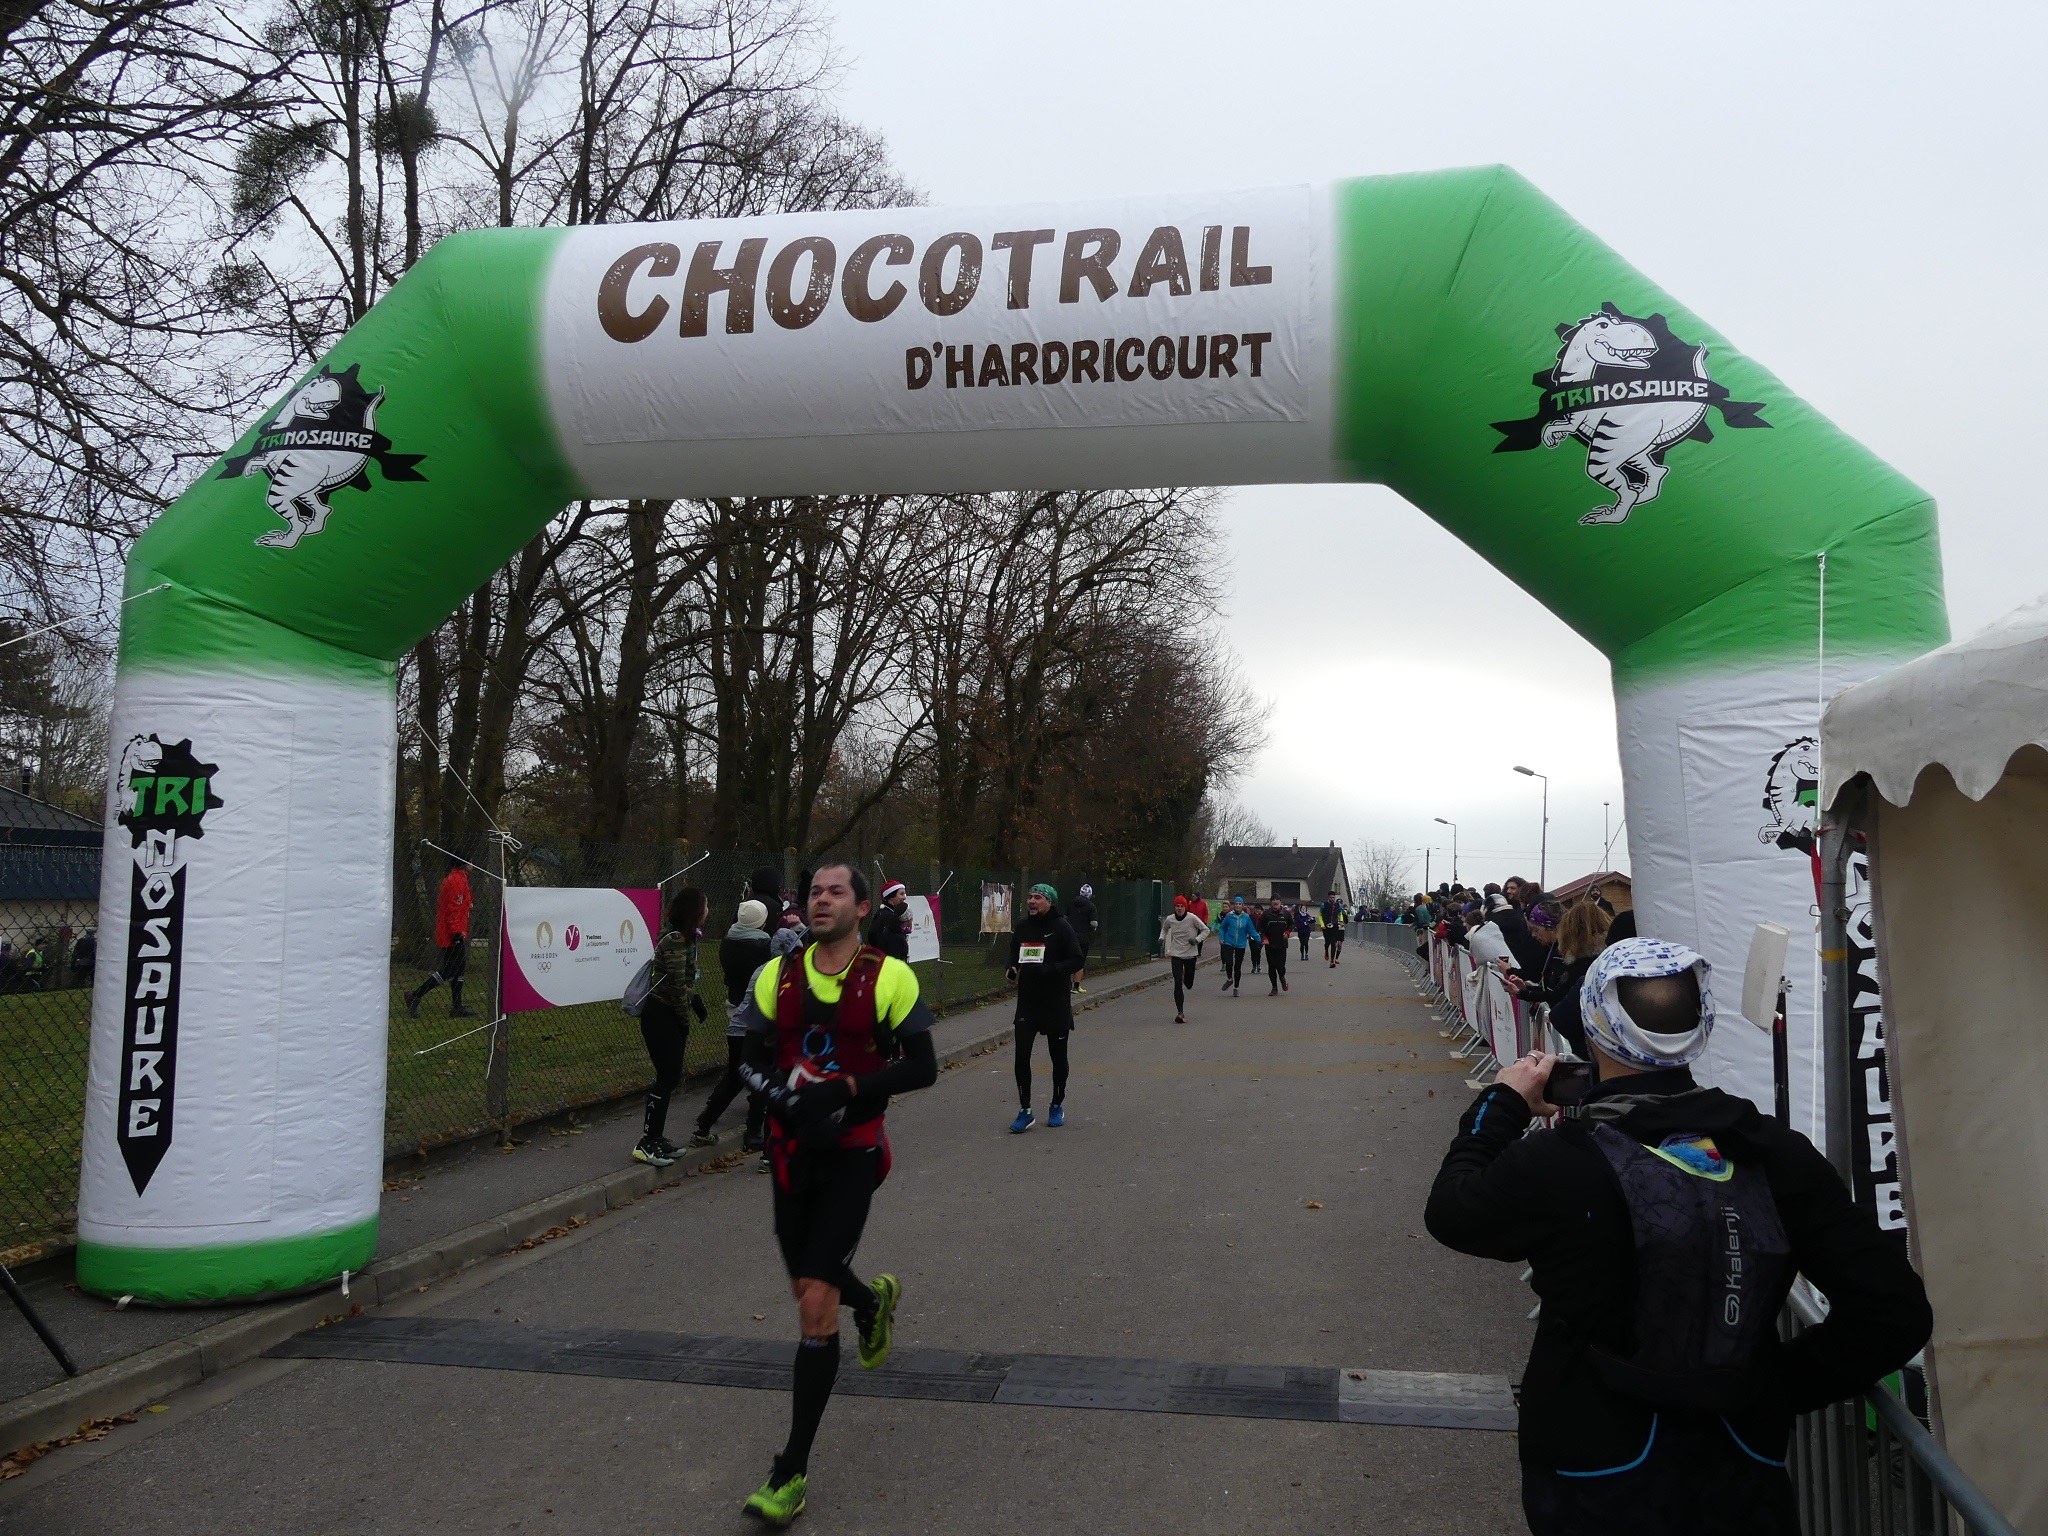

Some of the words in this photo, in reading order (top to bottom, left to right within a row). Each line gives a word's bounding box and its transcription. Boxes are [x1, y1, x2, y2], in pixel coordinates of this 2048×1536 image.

[597, 224, 1273, 343] CHOCOTRAIL
[905, 332, 1272, 390] D'HARDRICOURT
[1551, 380, 1709, 411] TRINOSAURE
[260, 429, 373, 450] TRINOSAURE
[131, 776, 207, 818] TRI
[128, 829, 177, 1138] NOSAURE
